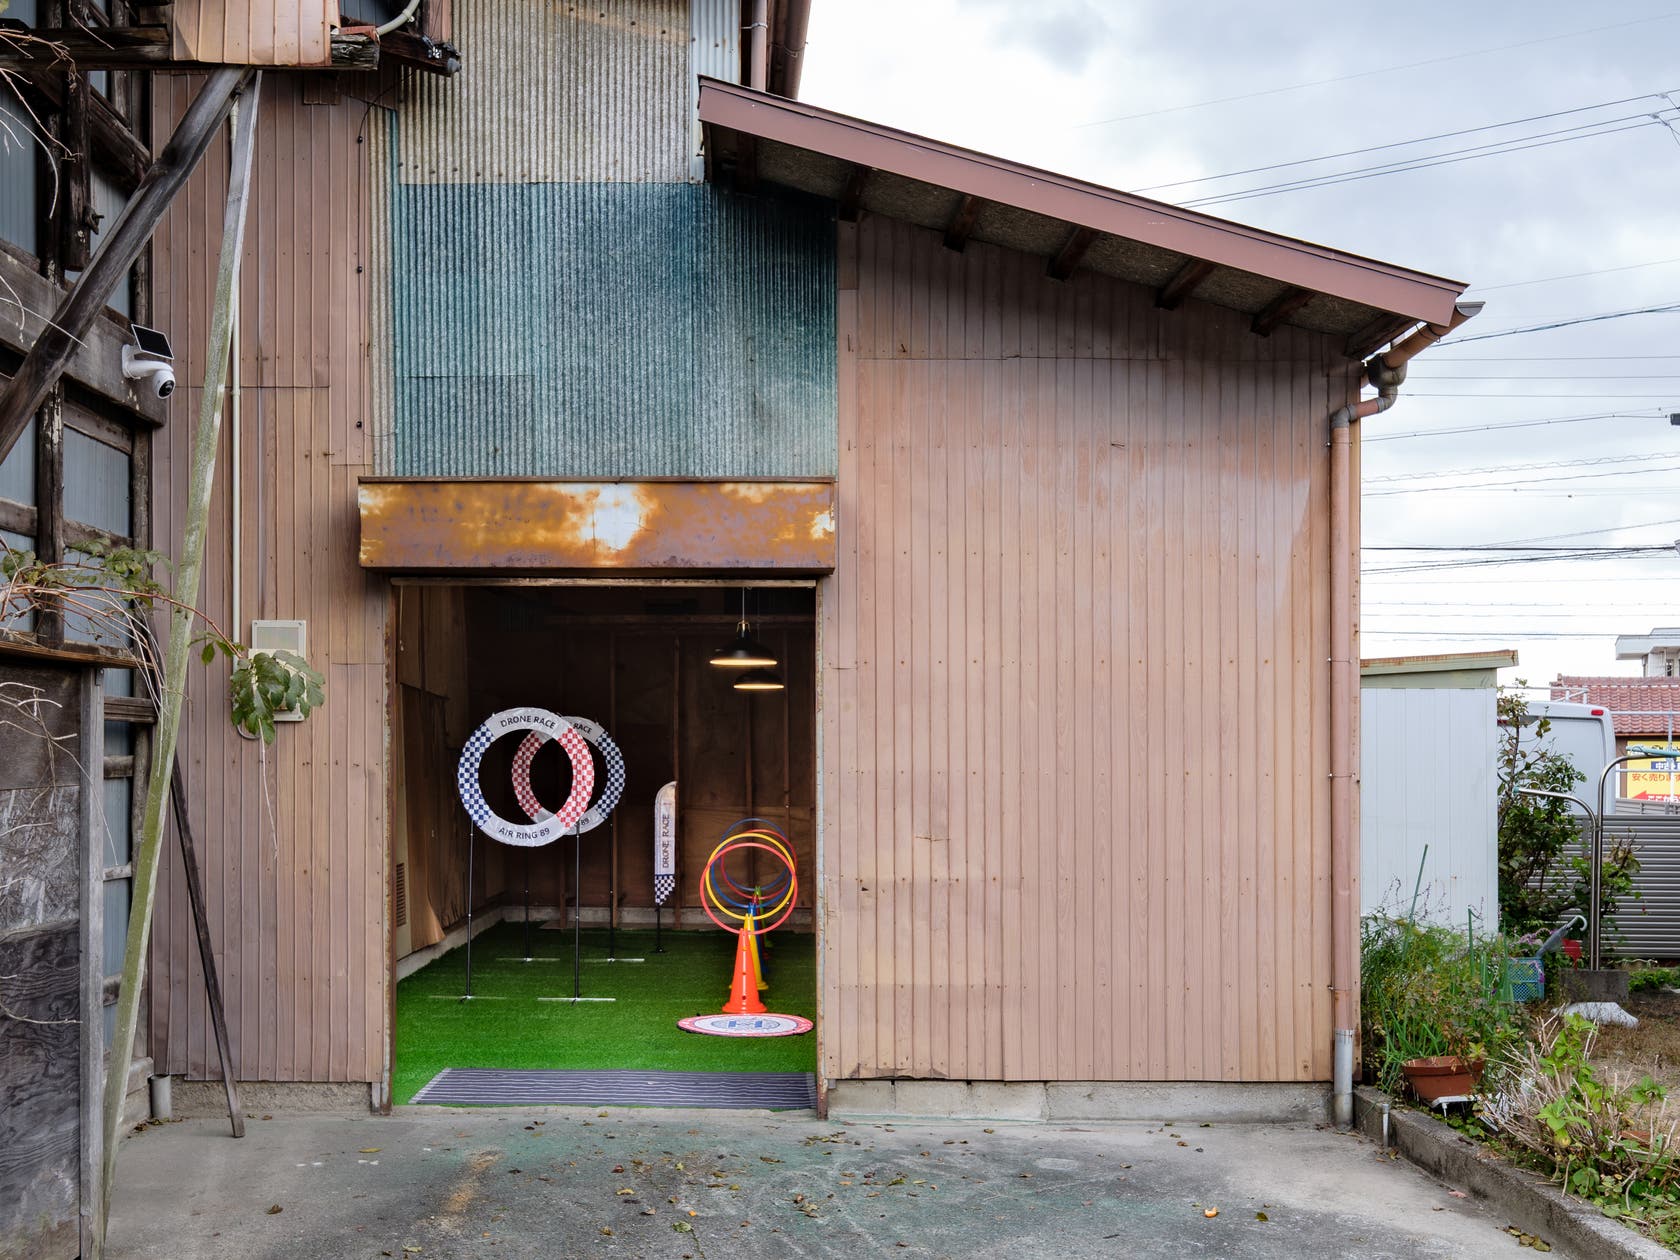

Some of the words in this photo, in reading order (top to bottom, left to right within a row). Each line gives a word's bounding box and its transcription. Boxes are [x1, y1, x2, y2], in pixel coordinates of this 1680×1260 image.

[500, 715, 532, 728] DRONE
[533, 716, 557, 730] RACE
[573, 722, 593, 734] RACE
[581, 817, 590, 825] 89
[662, 814, 670, 837] RACE
[498, 827, 513, 838] AIR
[515, 828, 538, 840] RING
[539, 827, 551, 837] 89
[662, 841, 670, 868] DRONE
